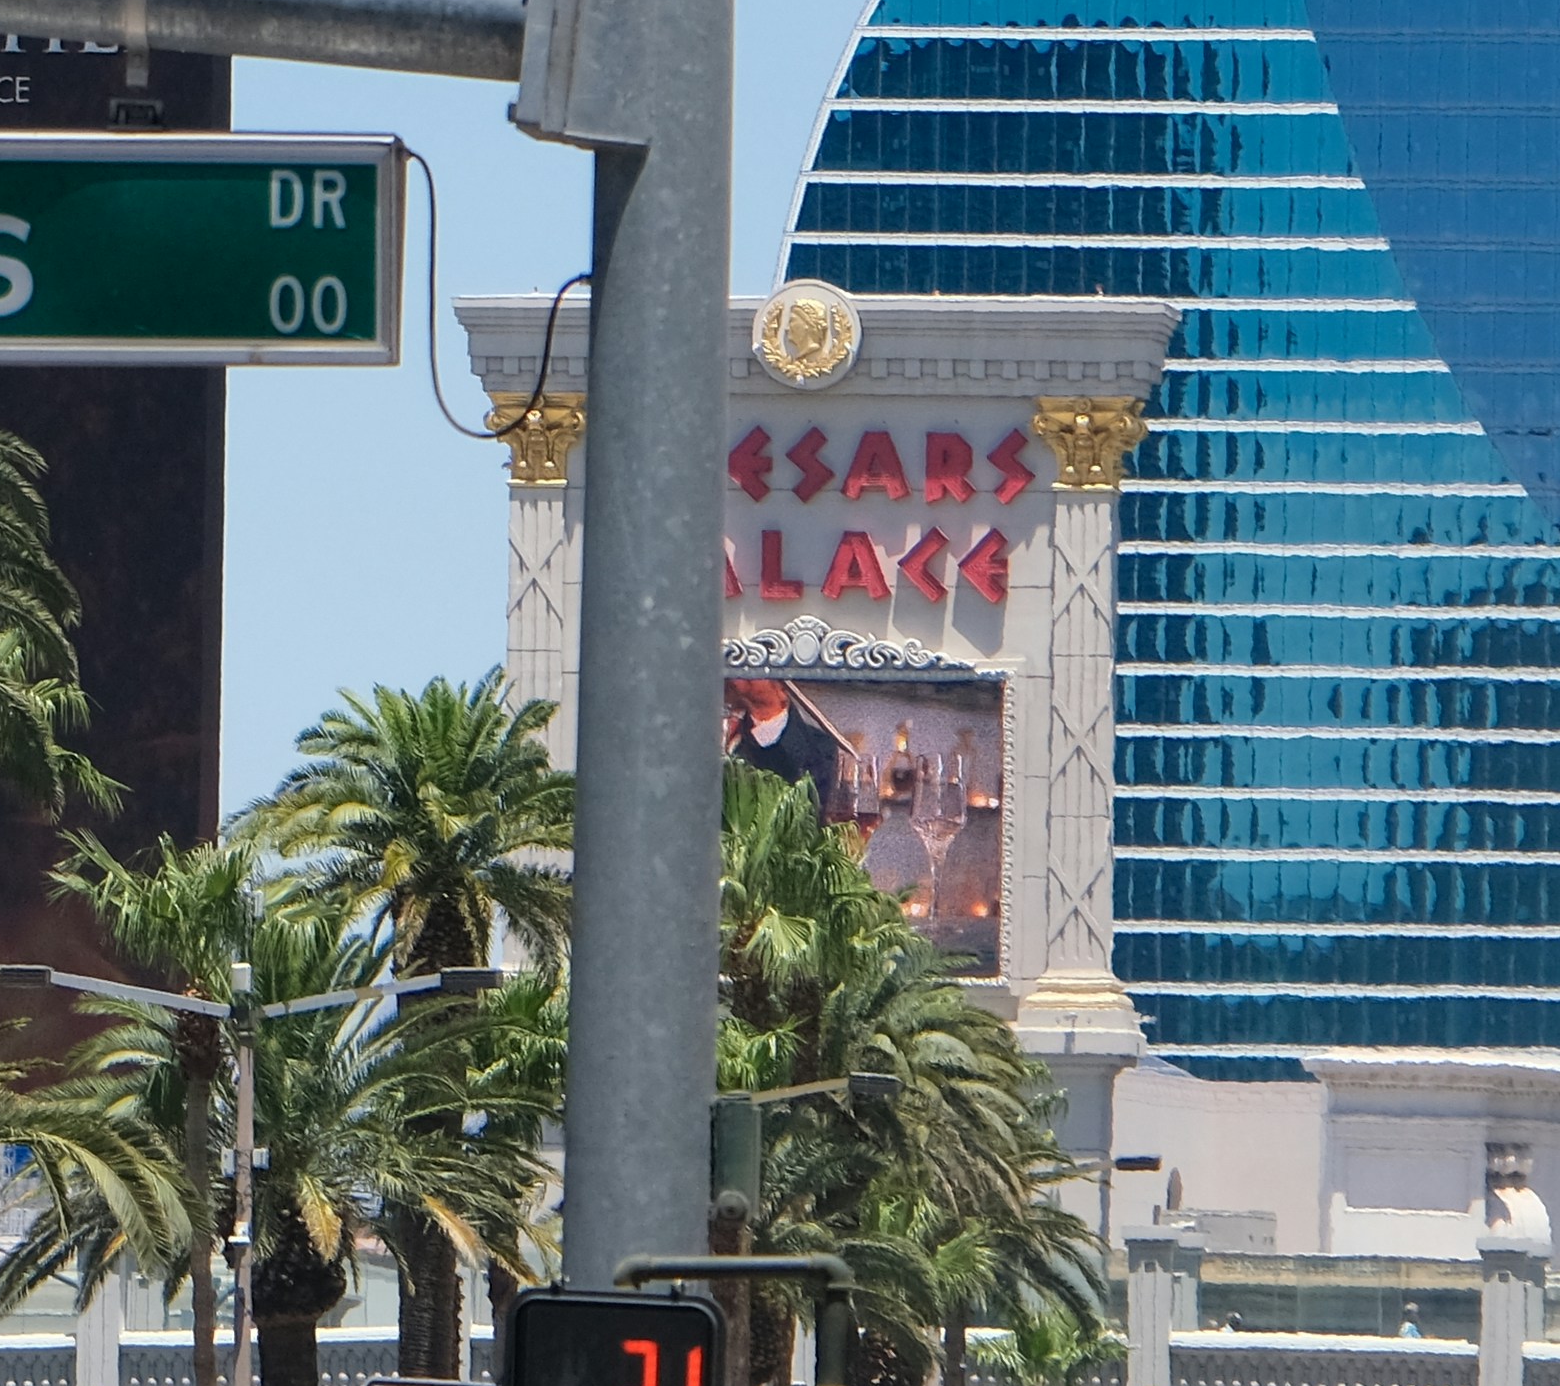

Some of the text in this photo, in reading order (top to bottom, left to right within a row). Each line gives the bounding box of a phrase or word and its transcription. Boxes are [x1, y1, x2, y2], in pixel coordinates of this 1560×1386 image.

[269, 169, 349, 230] DR
[727, 425, 1036, 505] ESARS
[724, 526, 1009, 605] LACE
